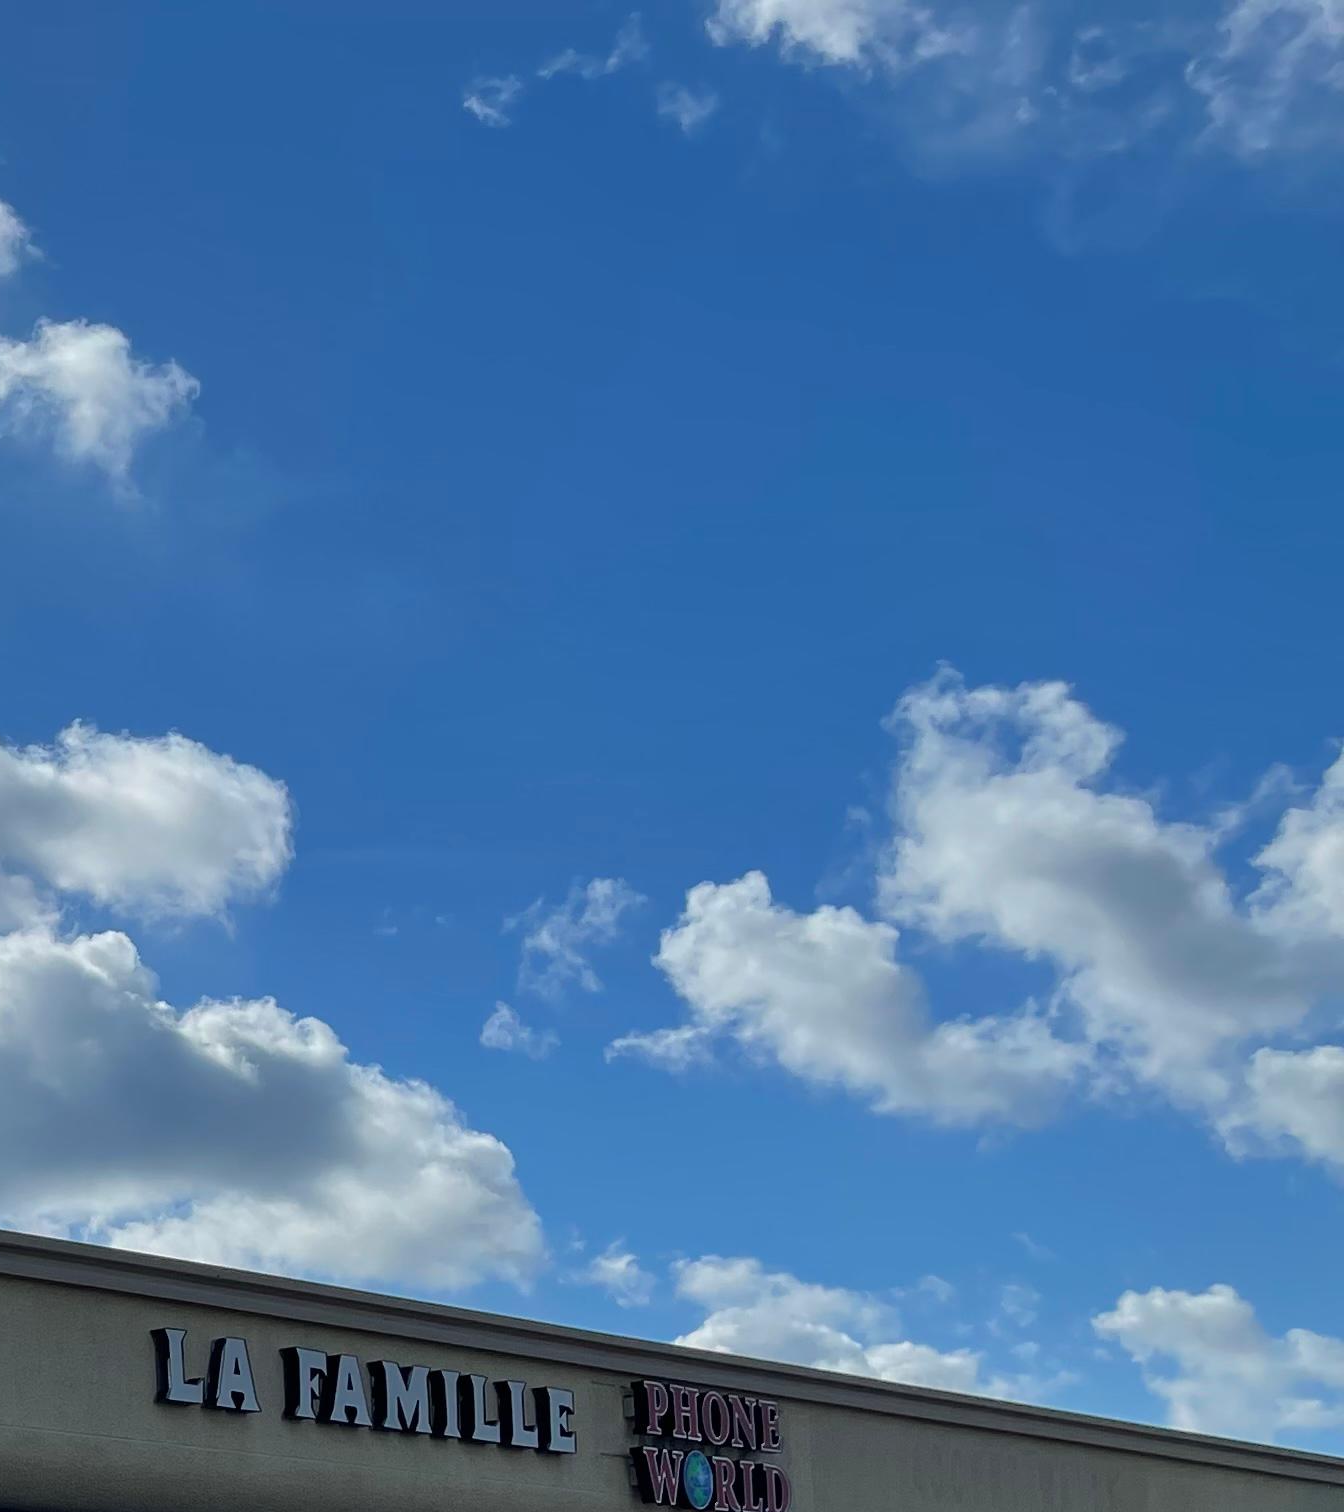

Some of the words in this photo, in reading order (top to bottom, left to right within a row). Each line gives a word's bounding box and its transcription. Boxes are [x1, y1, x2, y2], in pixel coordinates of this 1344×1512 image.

[150, 1327, 263, 1413] LA
[280, 1346, 578, 1455] FAMILLE
[633, 1378, 785, 1455] PHONE
